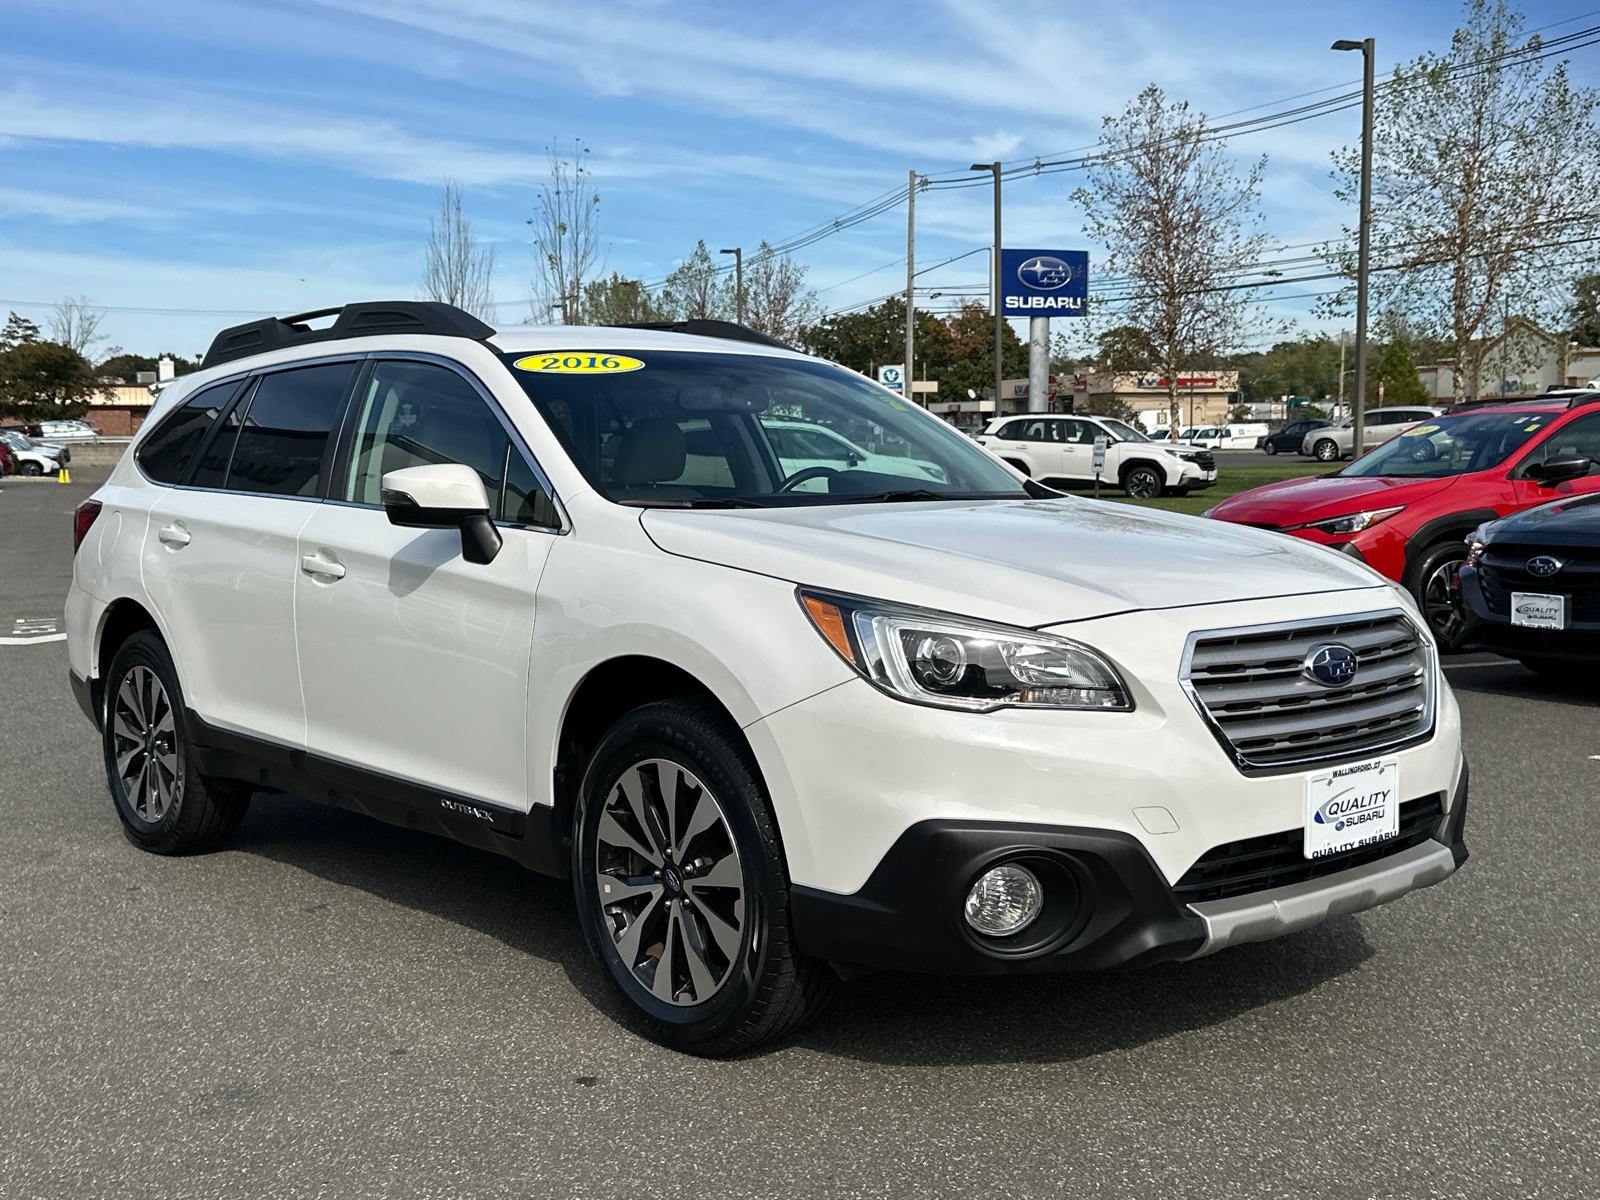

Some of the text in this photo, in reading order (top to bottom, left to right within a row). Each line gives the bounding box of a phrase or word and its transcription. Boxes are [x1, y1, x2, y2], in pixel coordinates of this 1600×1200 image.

[1005, 296, 1081, 309] SUBARU
[541, 356, 620, 369] 2016
[1523, 606, 1559, 614] QUALITY
[441, 798, 494, 822] OUTBACK
[1328, 789, 1390, 816] QUALITY
[1345, 809, 1385, 827] SUBARU
[1312, 830, 1397, 858] QUALITY SUBARU
